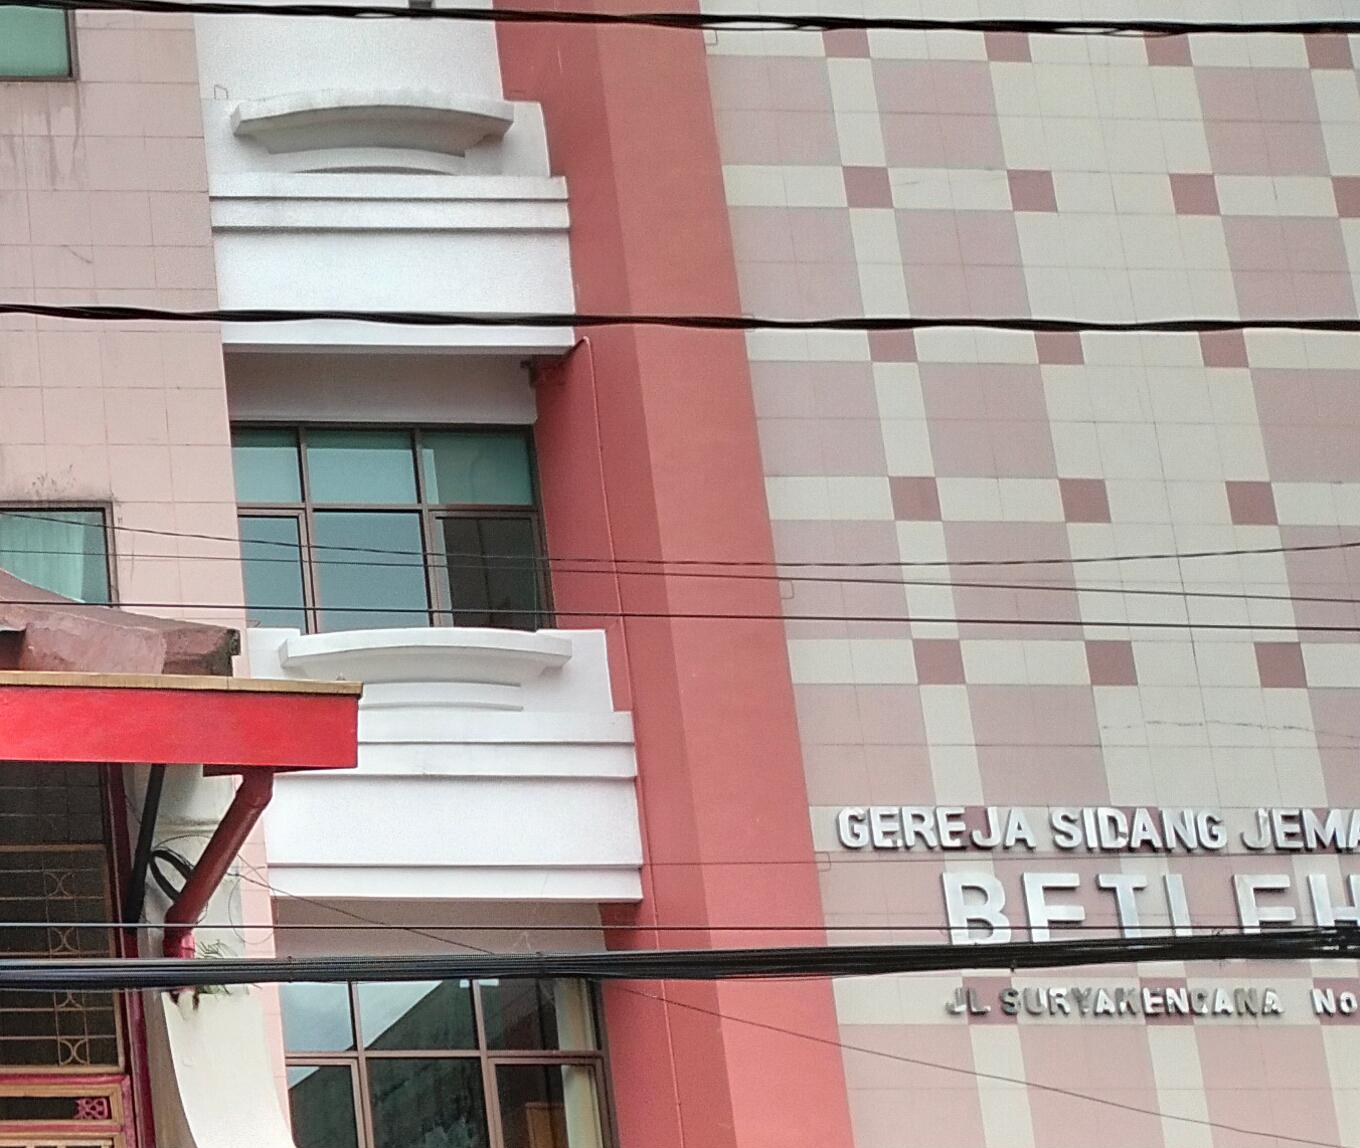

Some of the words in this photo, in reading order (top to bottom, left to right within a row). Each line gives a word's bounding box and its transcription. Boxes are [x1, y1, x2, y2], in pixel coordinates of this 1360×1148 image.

[837, 807, 1037, 852] GEREJA
[1050, 807, 1229, 852] SIDANG
[999, 985, 1284, 1016] SURYAKENCANA
